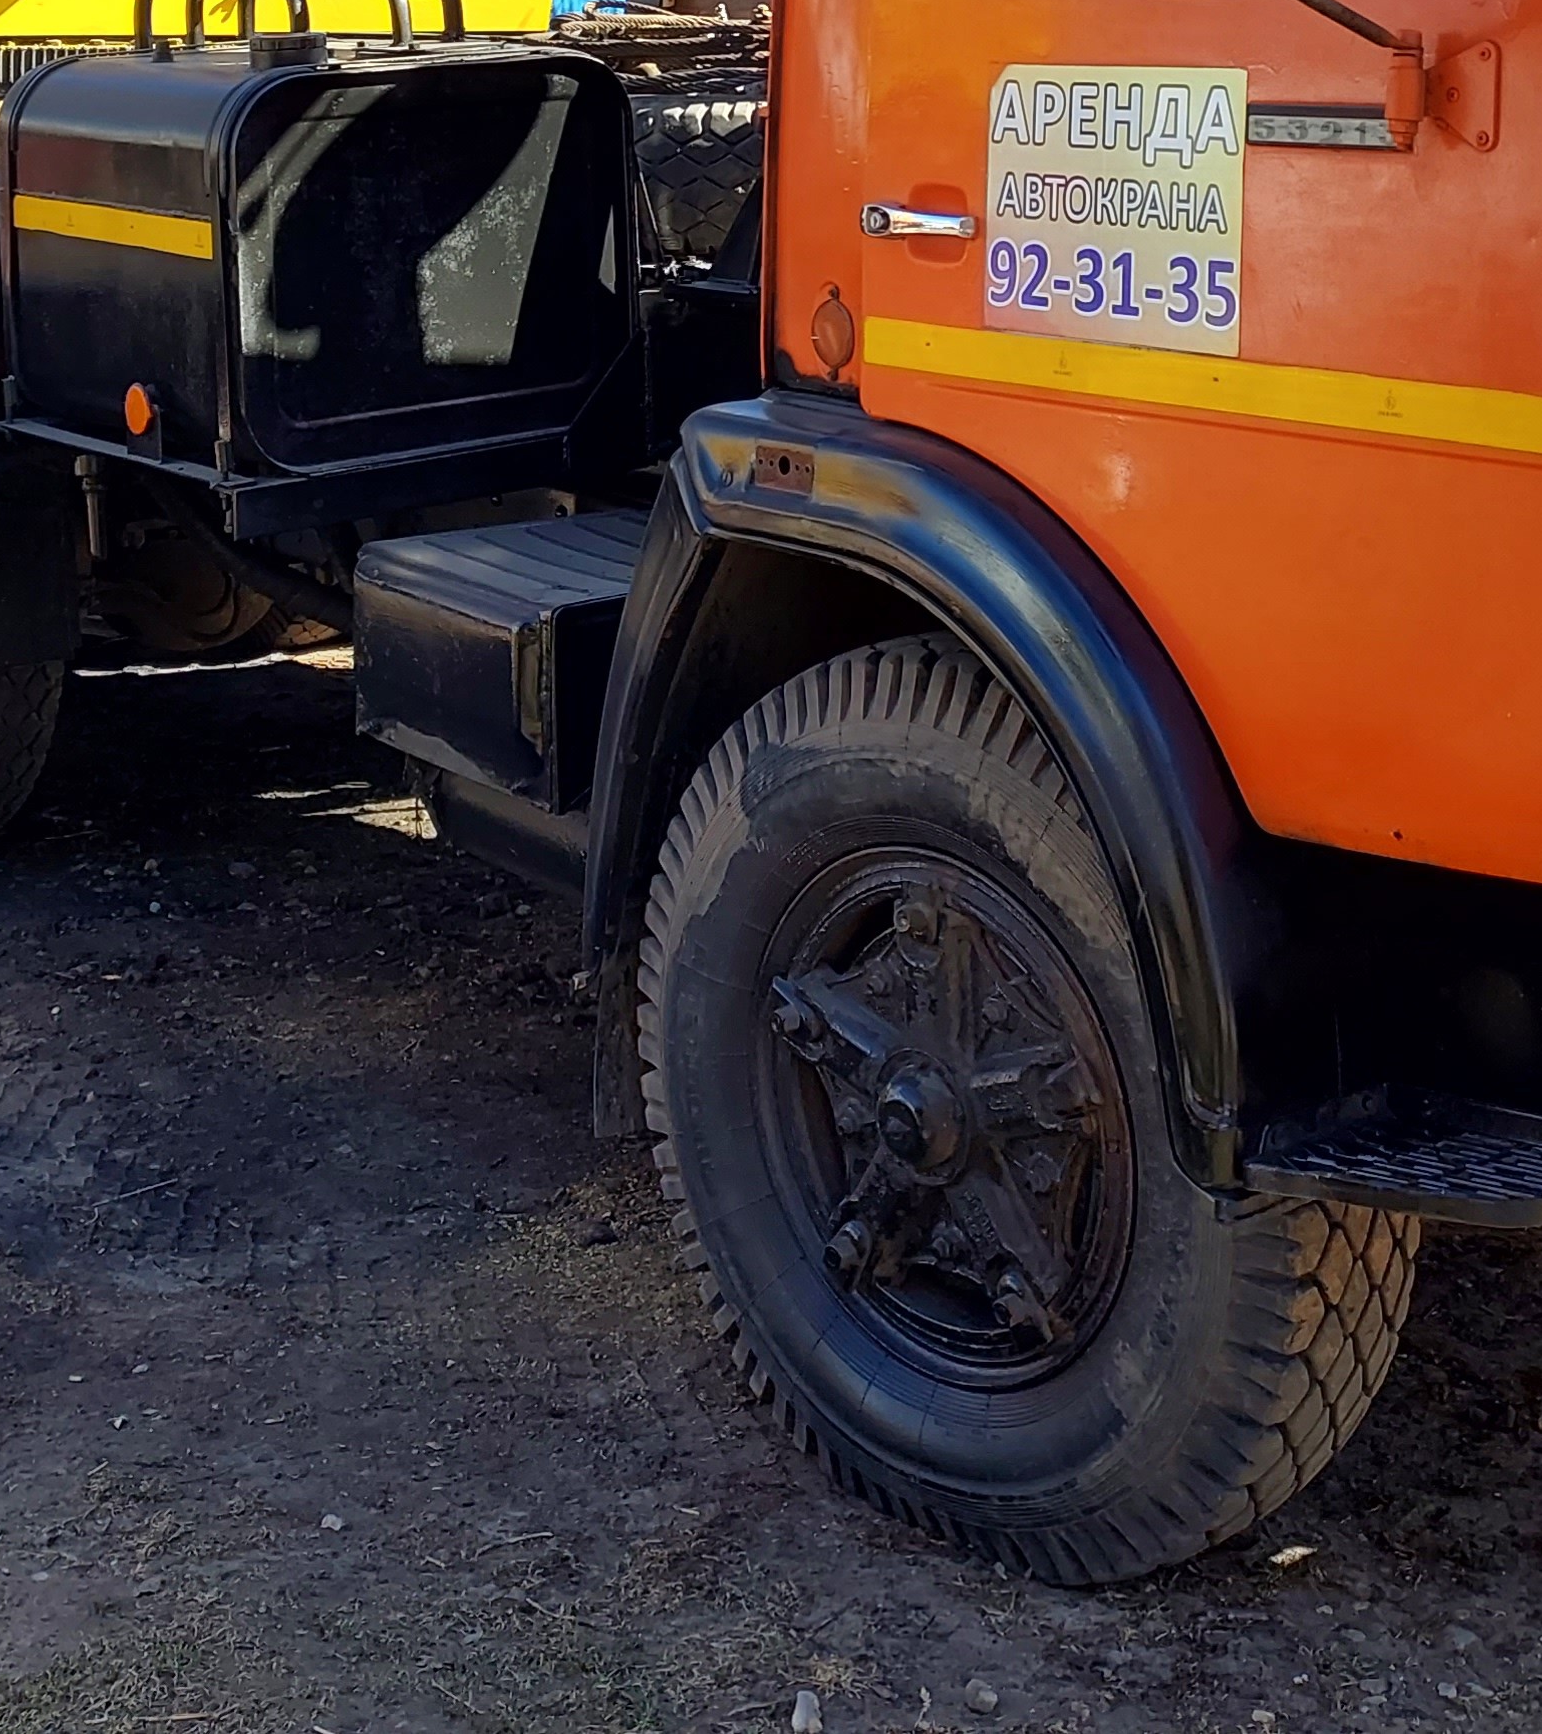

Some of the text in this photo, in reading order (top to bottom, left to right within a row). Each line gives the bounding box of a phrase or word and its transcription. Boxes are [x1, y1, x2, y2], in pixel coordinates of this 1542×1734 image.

[992, 79, 1239, 168] АРЕНДА
[996, 172, 1228, 234] АВТОКРАНА
[987, 238, 1239, 331] 92-31-35
